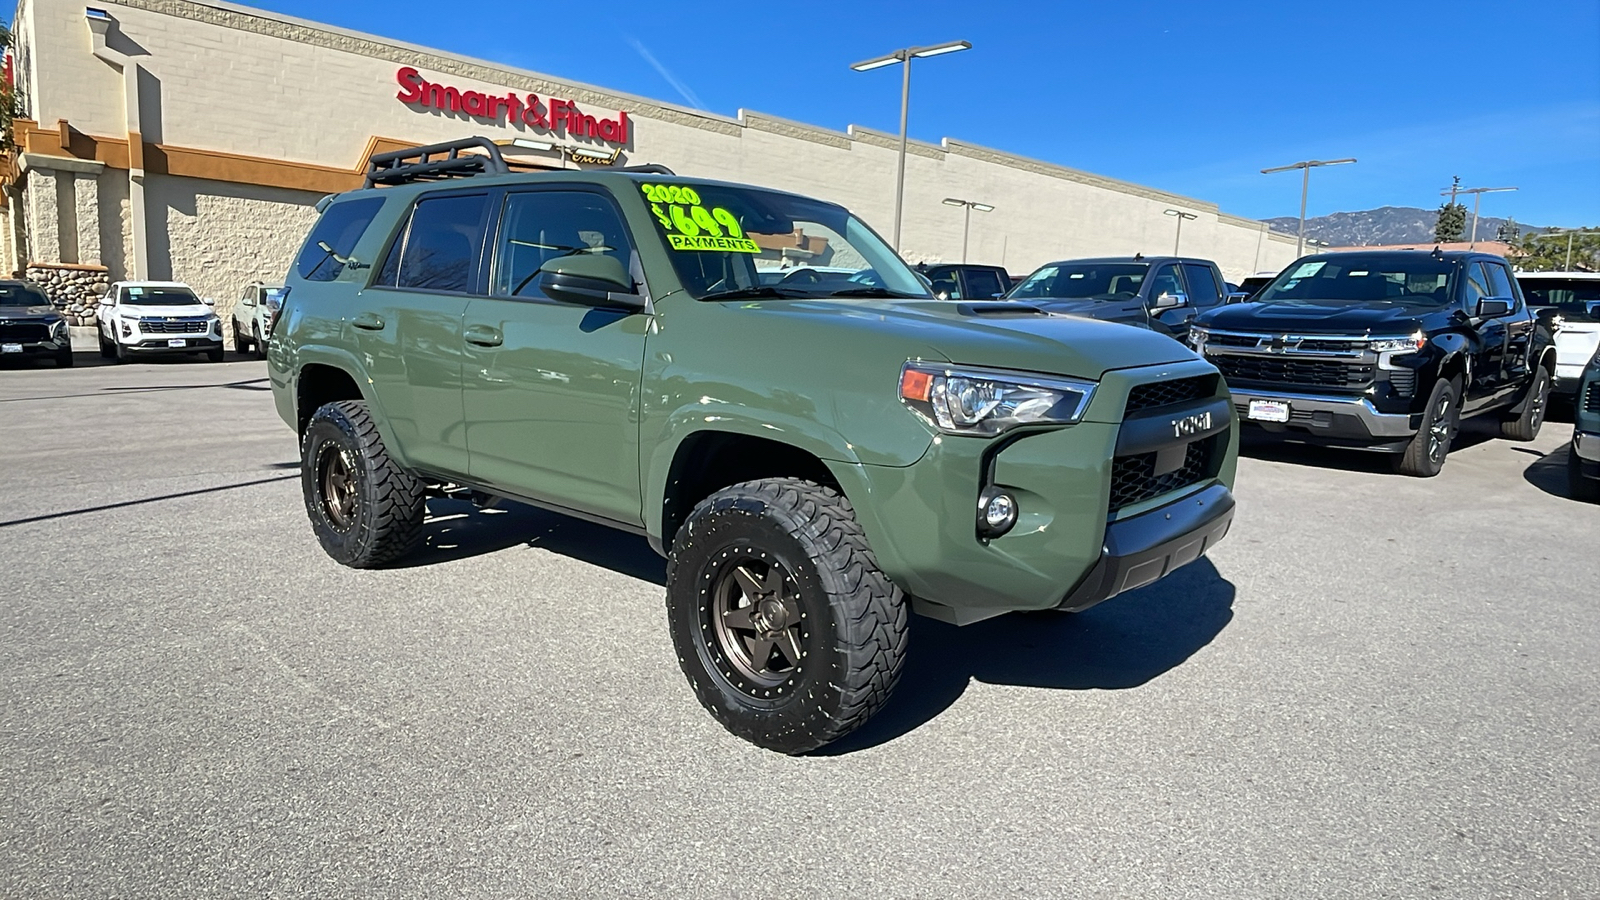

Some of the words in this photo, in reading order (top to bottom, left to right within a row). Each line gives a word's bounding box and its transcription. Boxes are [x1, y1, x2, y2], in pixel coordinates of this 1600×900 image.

[396, 66, 521, 123] Smart
[549, 98, 628, 144] Final
[641, 183, 701, 206] 2020
[651, 202, 743, 239] $649
[671, 236, 756, 251] PAYMENTS
